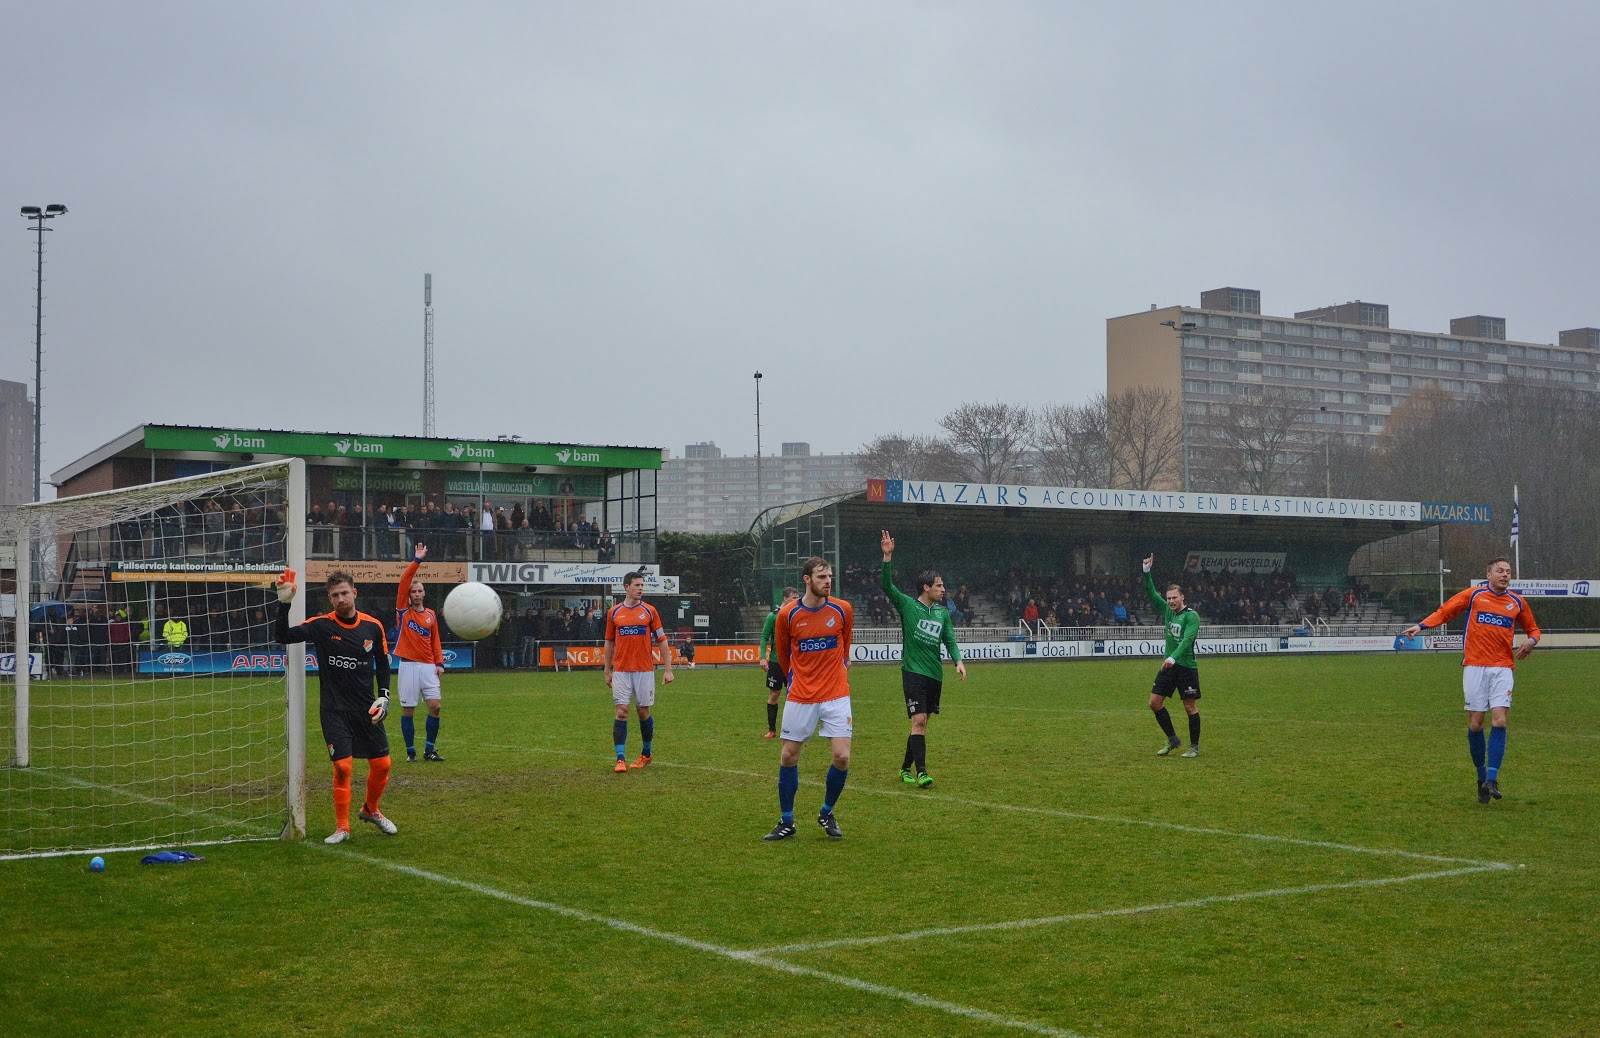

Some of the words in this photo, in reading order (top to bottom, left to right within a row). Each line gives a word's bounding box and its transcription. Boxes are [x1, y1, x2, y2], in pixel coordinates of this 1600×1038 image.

[233, 434, 265, 448] bam
[353, 439, 384, 453] bam
[466, 444, 495, 458] bam
[573, 449, 600, 463] bam
[491, 482, 533, 493] ADVOCATEN
[870, 484, 882, 497] M
[907, 482, 1028, 506] MAZARS
[1043, 490, 1185, 509] ACCOUNTANTS
[1197, 496, 1218, 510] EN
[1230, 497, 1416, 518] BELASTINGADVISEURS
[1421, 504, 1491, 522] MAZARS.NL
[117, 561, 167, 570] Fullservice
[1200, 557, 1282, 568] BEHANGWERELD.NL
[472, 564, 549, 582] TWIGT
[919, 620, 941, 633] UTI
[726, 649, 754, 661] ING
[1042, 642, 1080, 657] doa.nl
[1108, 641, 1133, 655] den
[232, 654, 319, 669] ARDA
[564, 651, 589, 664] NG
